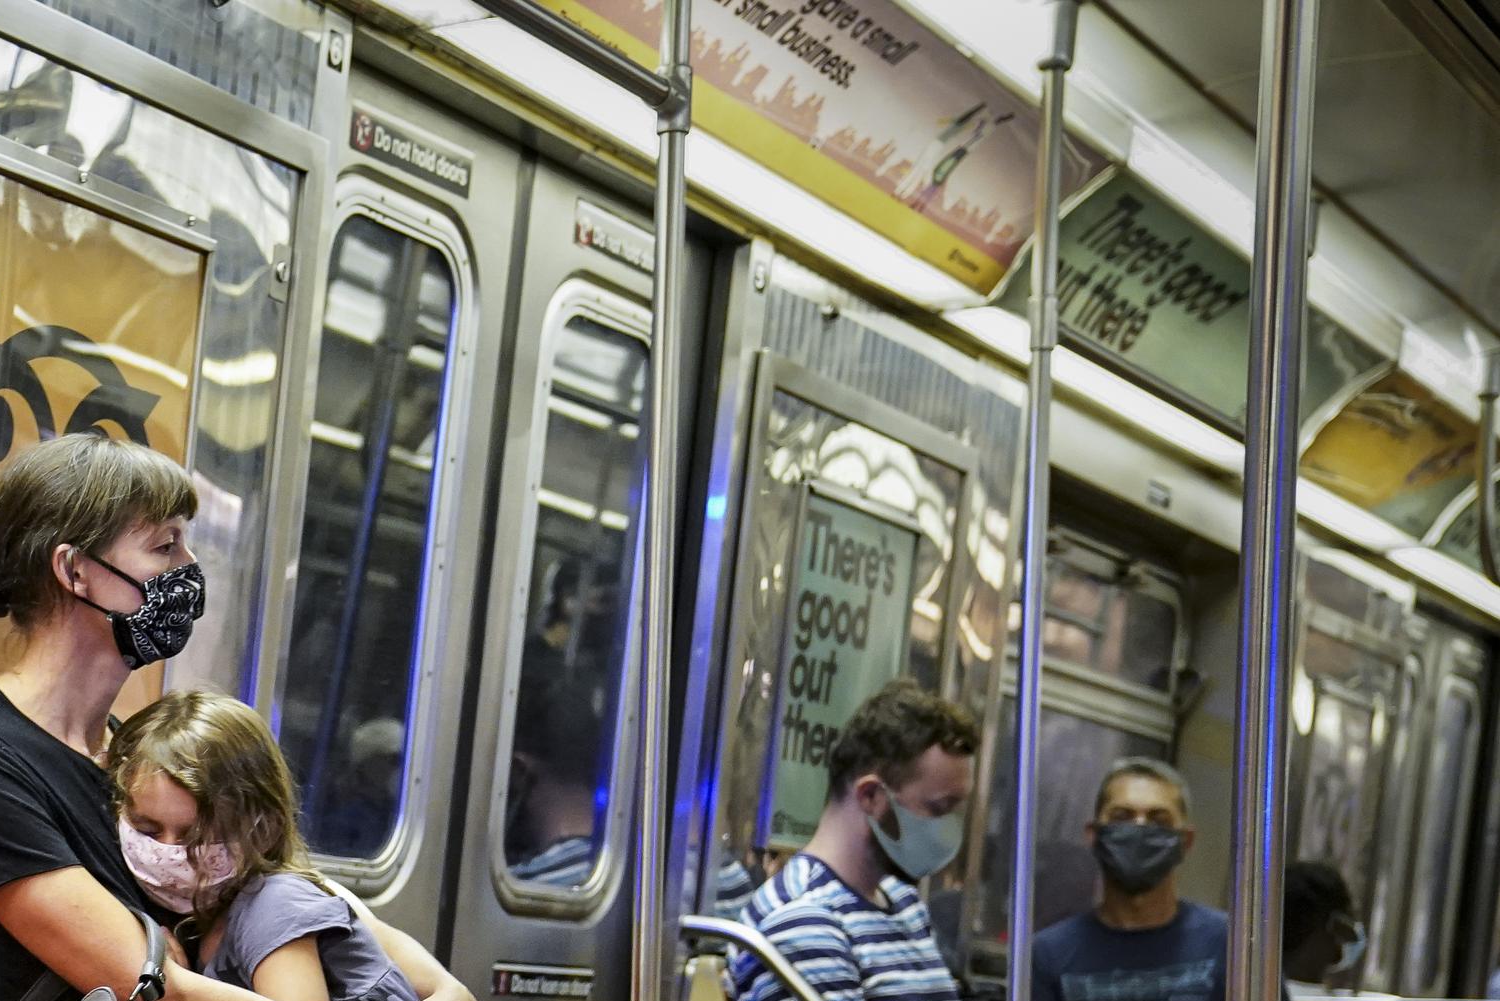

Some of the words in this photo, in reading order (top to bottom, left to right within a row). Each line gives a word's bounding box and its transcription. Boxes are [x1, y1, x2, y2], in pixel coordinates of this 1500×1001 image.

[734, 0, 796, 38] small
[778, 18, 857, 89] business.
[850, 17, 873, 39] a
[862, 26, 920, 67] small
[373, 125, 392, 153] Do
[391, 137, 412, 163] not
[410, 142, 437, 173] hold
[435, 155, 469, 187] doors
[1076, 192, 1192, 286] There's
[807, 508, 896, 597] There's
[795, 590, 873, 651] good
[788, 650, 838, 706] out
[781, 703, 839, 769] ther
